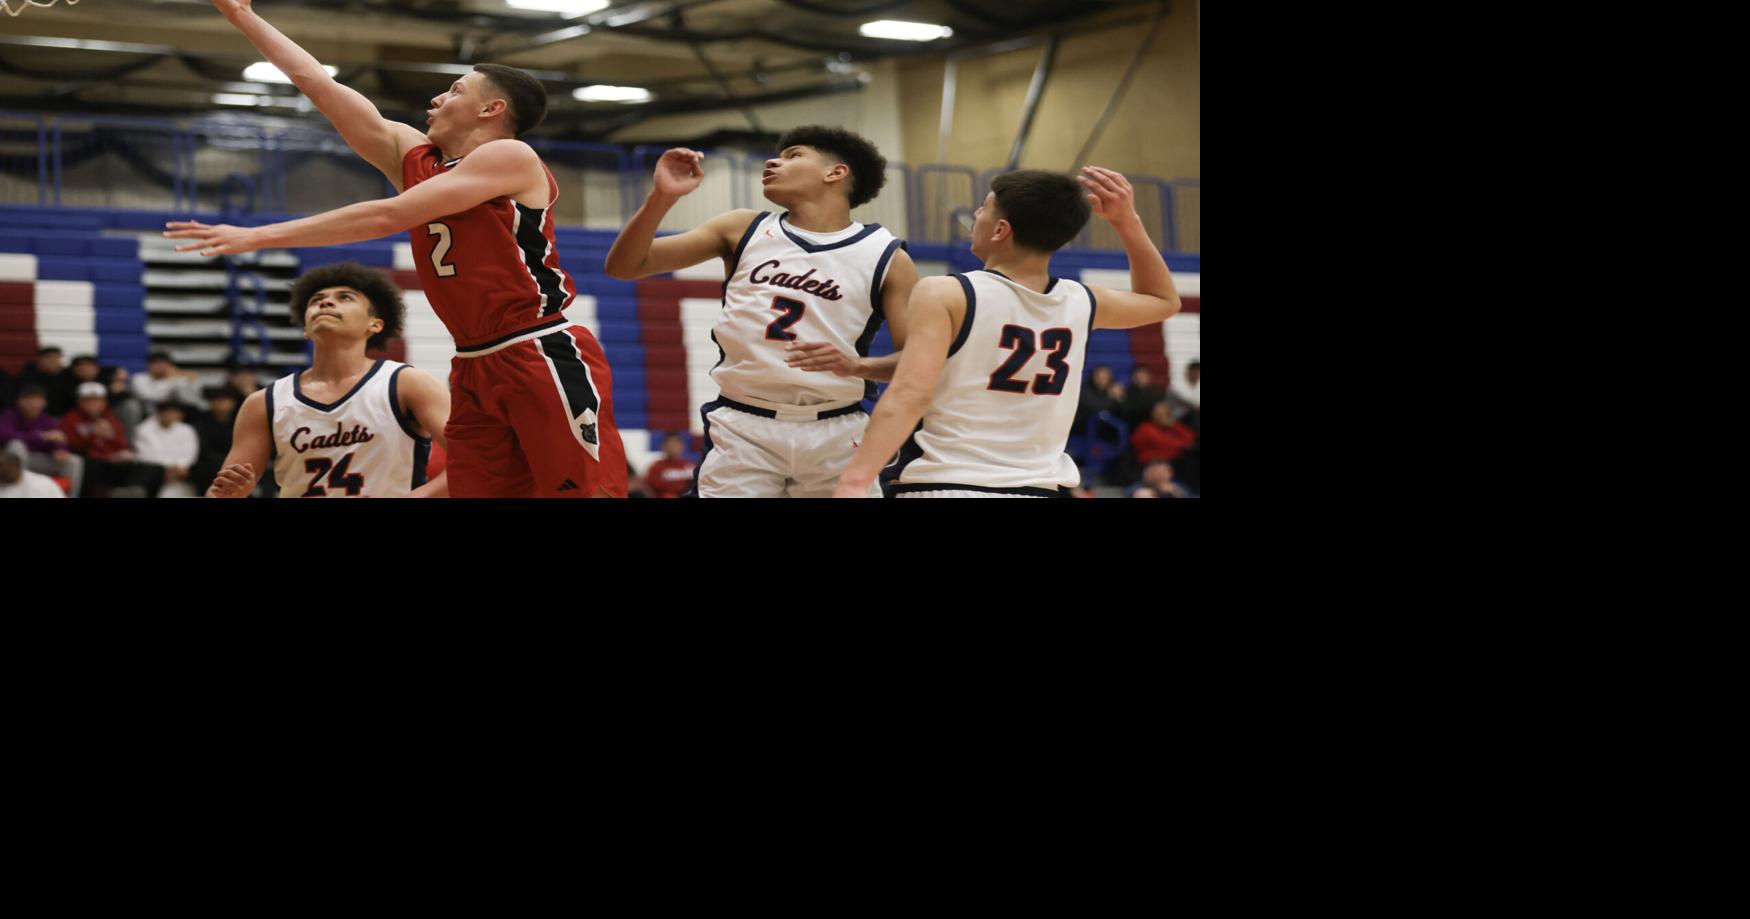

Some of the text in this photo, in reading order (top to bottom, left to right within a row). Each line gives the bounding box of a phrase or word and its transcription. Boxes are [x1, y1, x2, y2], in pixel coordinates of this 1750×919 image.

[427, 221, 457, 278] 2
[749, 259, 843, 301] Cadets
[765, 295, 806, 342] 2
[986, 323, 1073, 396] 23
[290, 421, 375, 454] Cadets
[301, 452, 365, 497] 24
